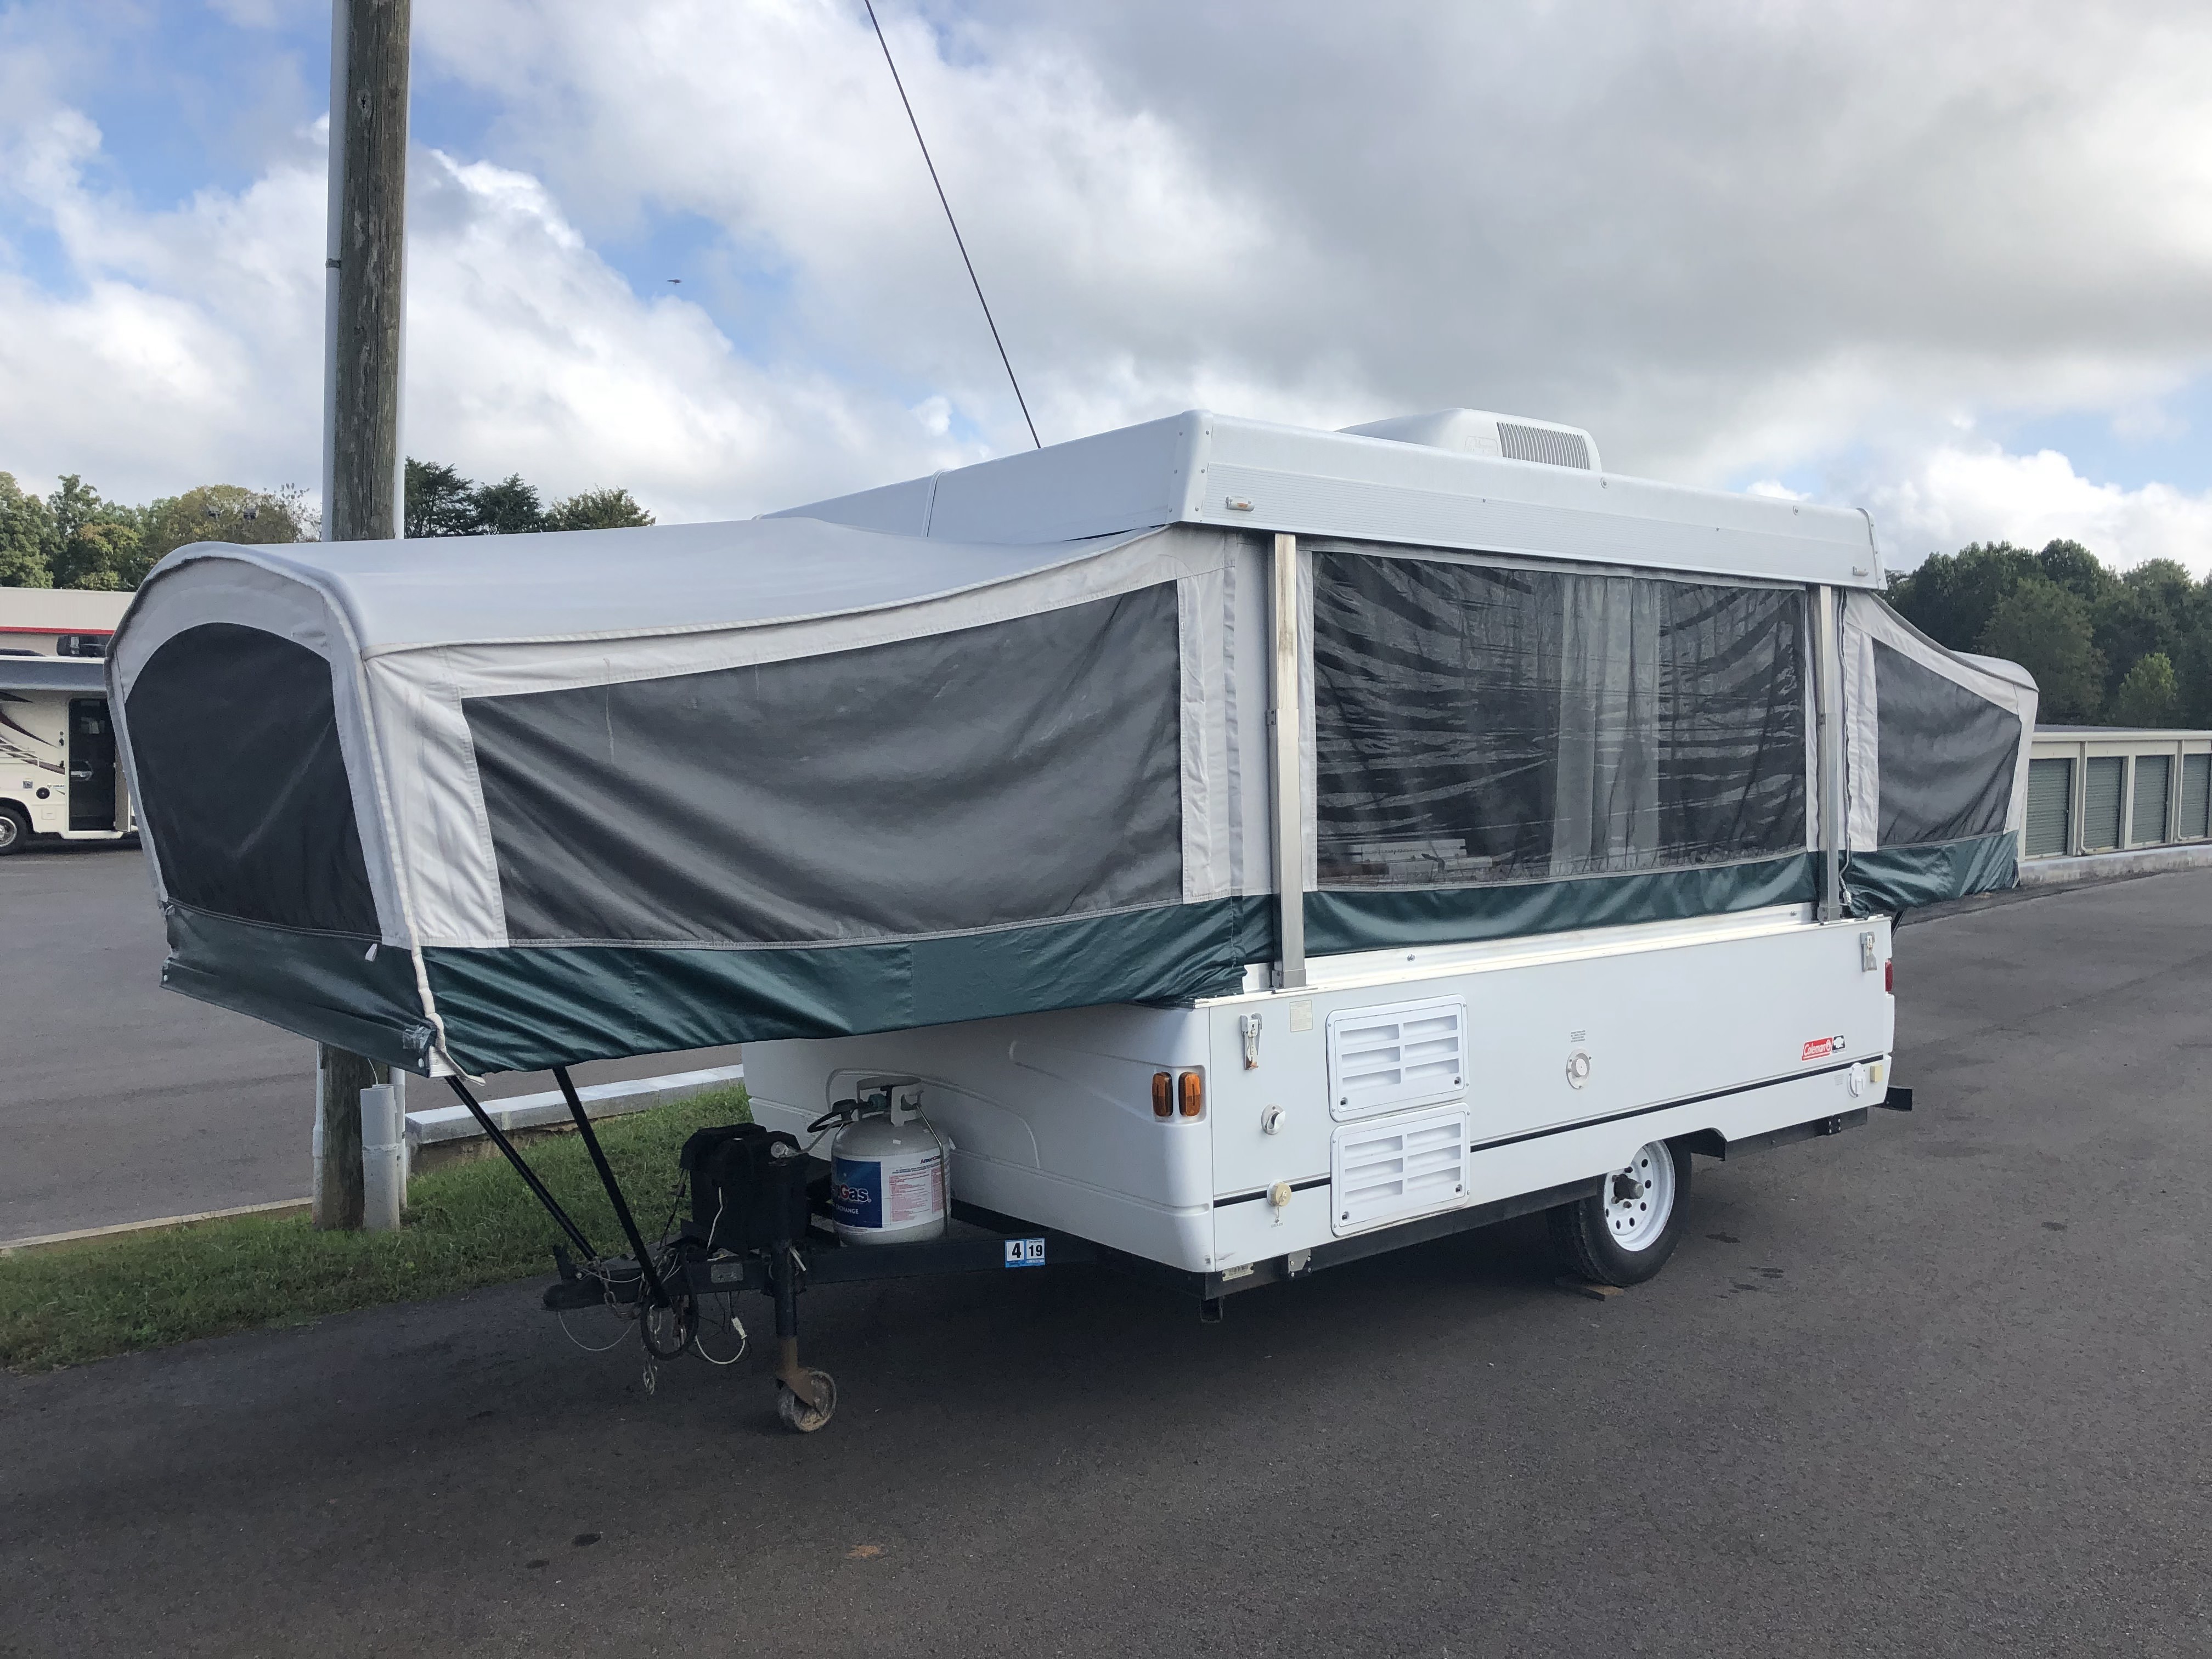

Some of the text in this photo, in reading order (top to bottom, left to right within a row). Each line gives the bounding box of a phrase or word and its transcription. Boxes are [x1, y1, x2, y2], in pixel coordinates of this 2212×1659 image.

[1804, 1042, 1826, 1056] Coleman
[1012, 1243, 1043, 1258] 4 19
